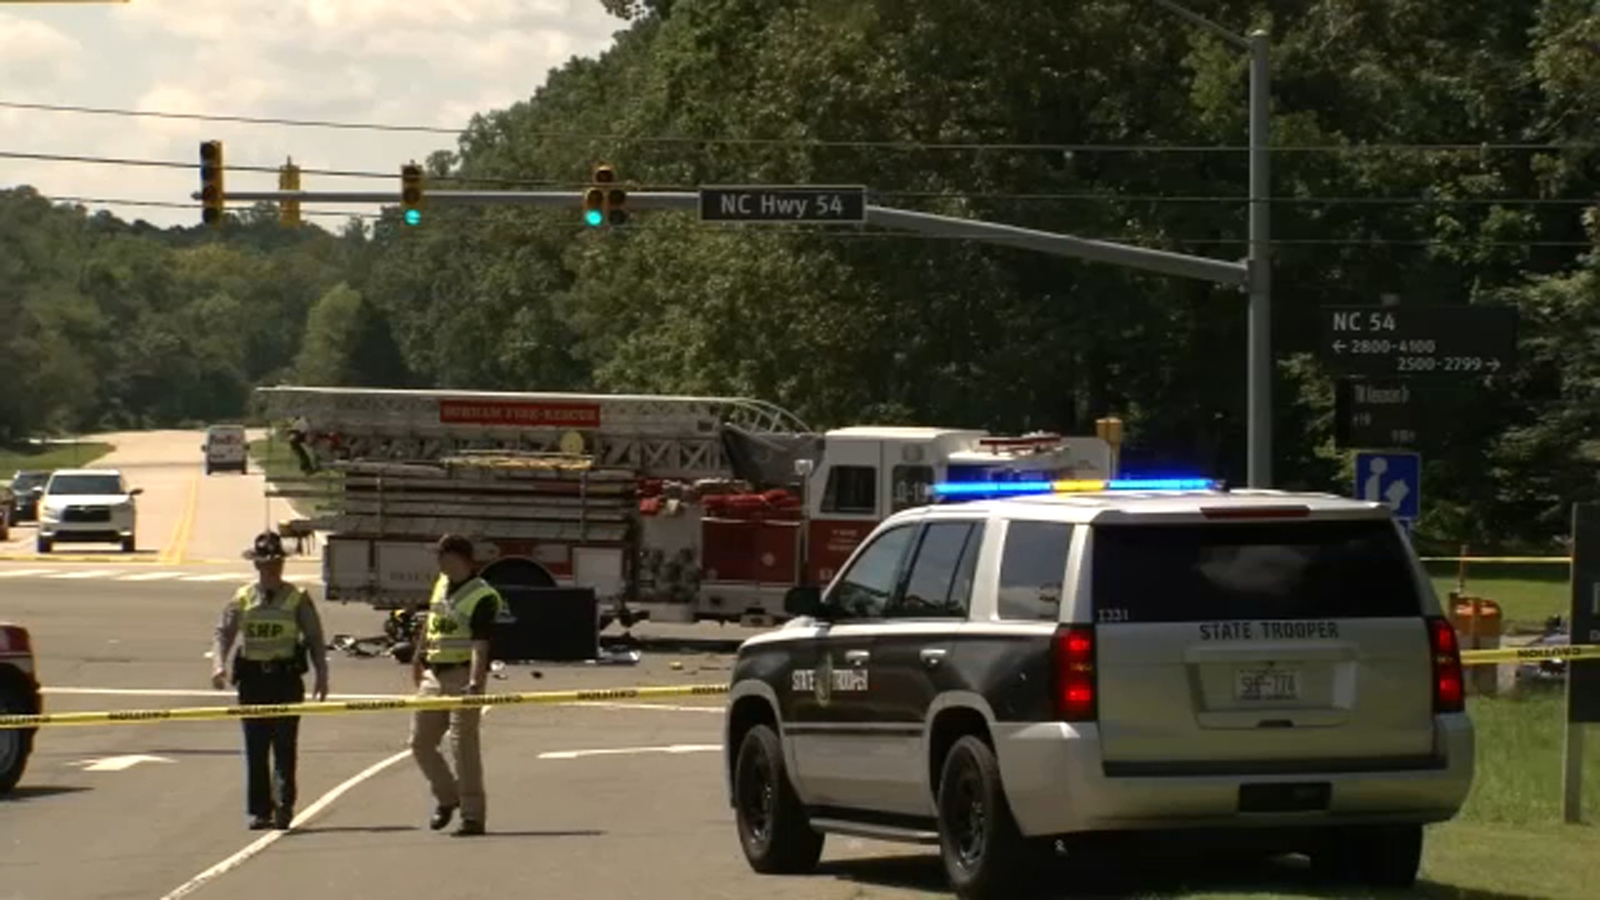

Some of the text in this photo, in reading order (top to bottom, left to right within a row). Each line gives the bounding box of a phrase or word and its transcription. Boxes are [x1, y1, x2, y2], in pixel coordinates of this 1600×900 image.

[721, 194, 843, 218] NC Hwy 54
[1333, 312, 1396, 331] NC 54
[1351, 339, 1436, 353] 2800-4100
[1396, 357, 1483, 371] 2500-2799
[246, 622, 284, 637] SHP
[1200, 621, 1340, 641] STATE TROOPER
[1517, 647, 1581, 657] CAUTION
